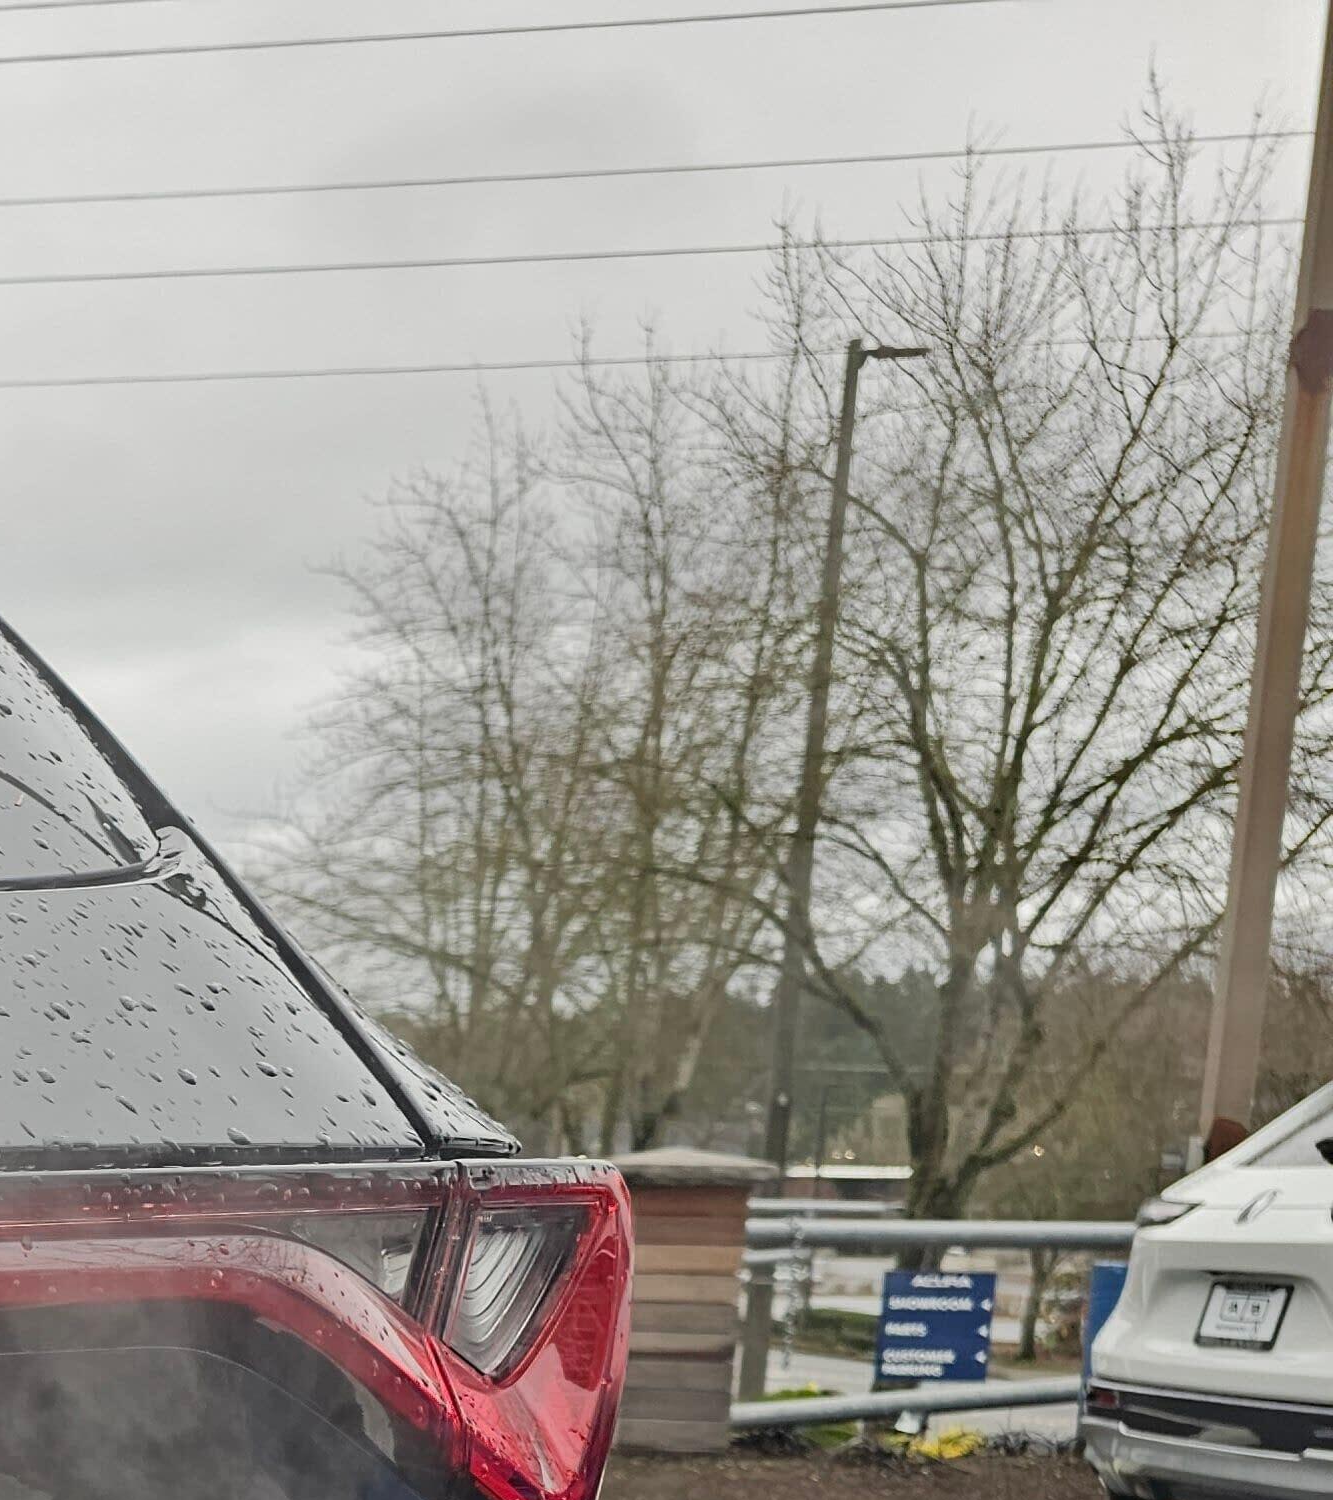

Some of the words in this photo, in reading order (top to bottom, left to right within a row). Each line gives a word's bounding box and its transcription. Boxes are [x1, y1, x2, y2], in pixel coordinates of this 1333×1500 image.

[889, 1295, 973, 1311] SHOWROOM
[885, 1322, 927, 1337] PARTS
[883, 1349, 955, 1364] CUSTOMER
